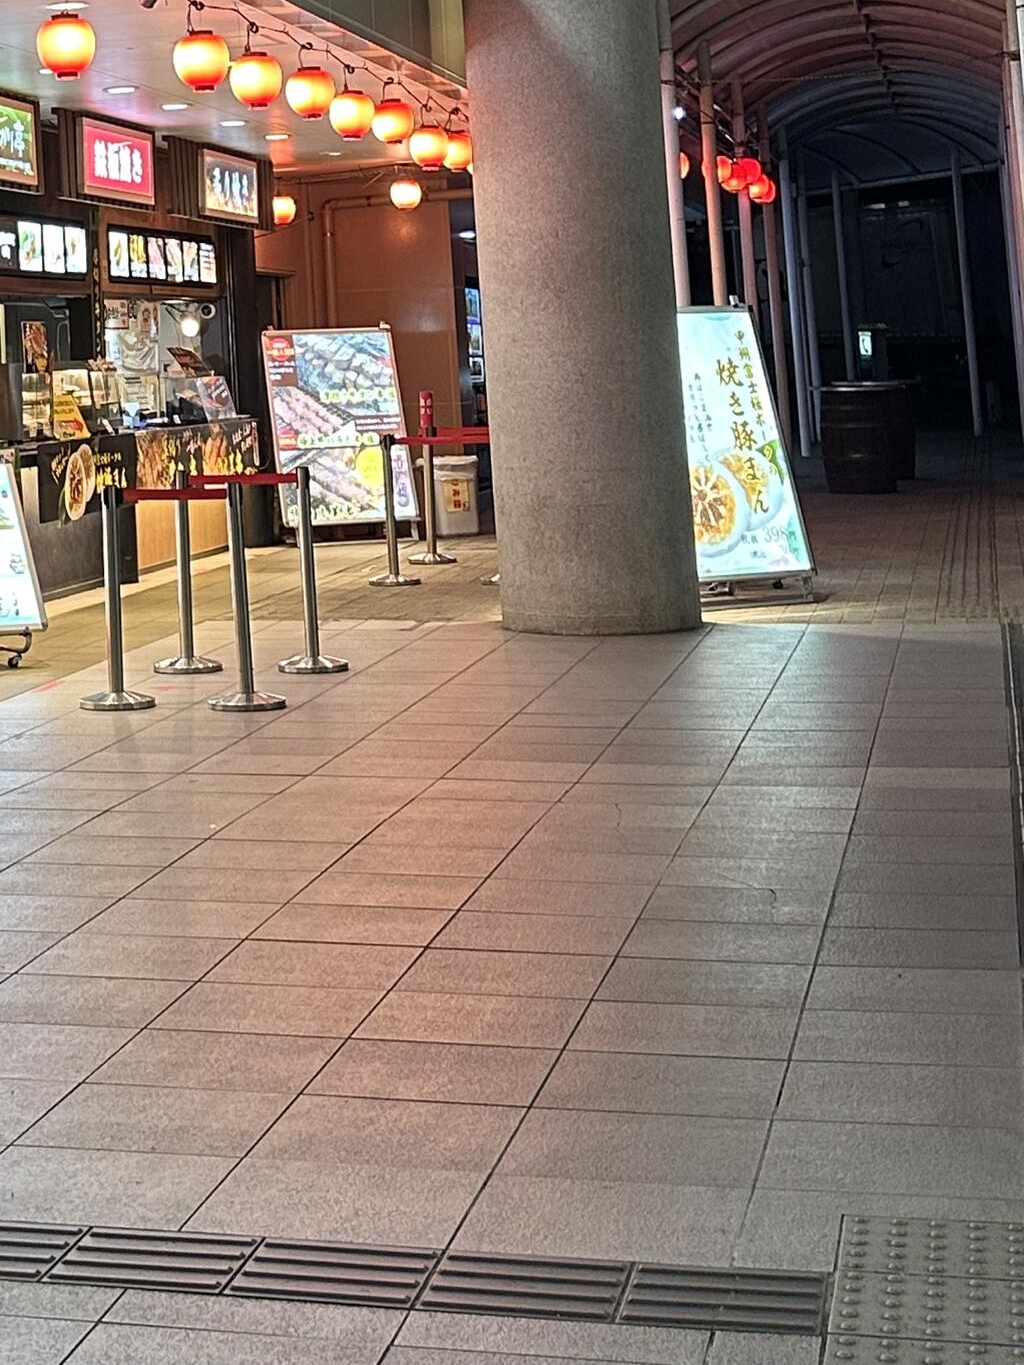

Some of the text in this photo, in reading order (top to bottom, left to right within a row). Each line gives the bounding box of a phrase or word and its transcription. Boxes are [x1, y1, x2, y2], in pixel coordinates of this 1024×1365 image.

[716, 356, 770, 515] 焼き豚まん
